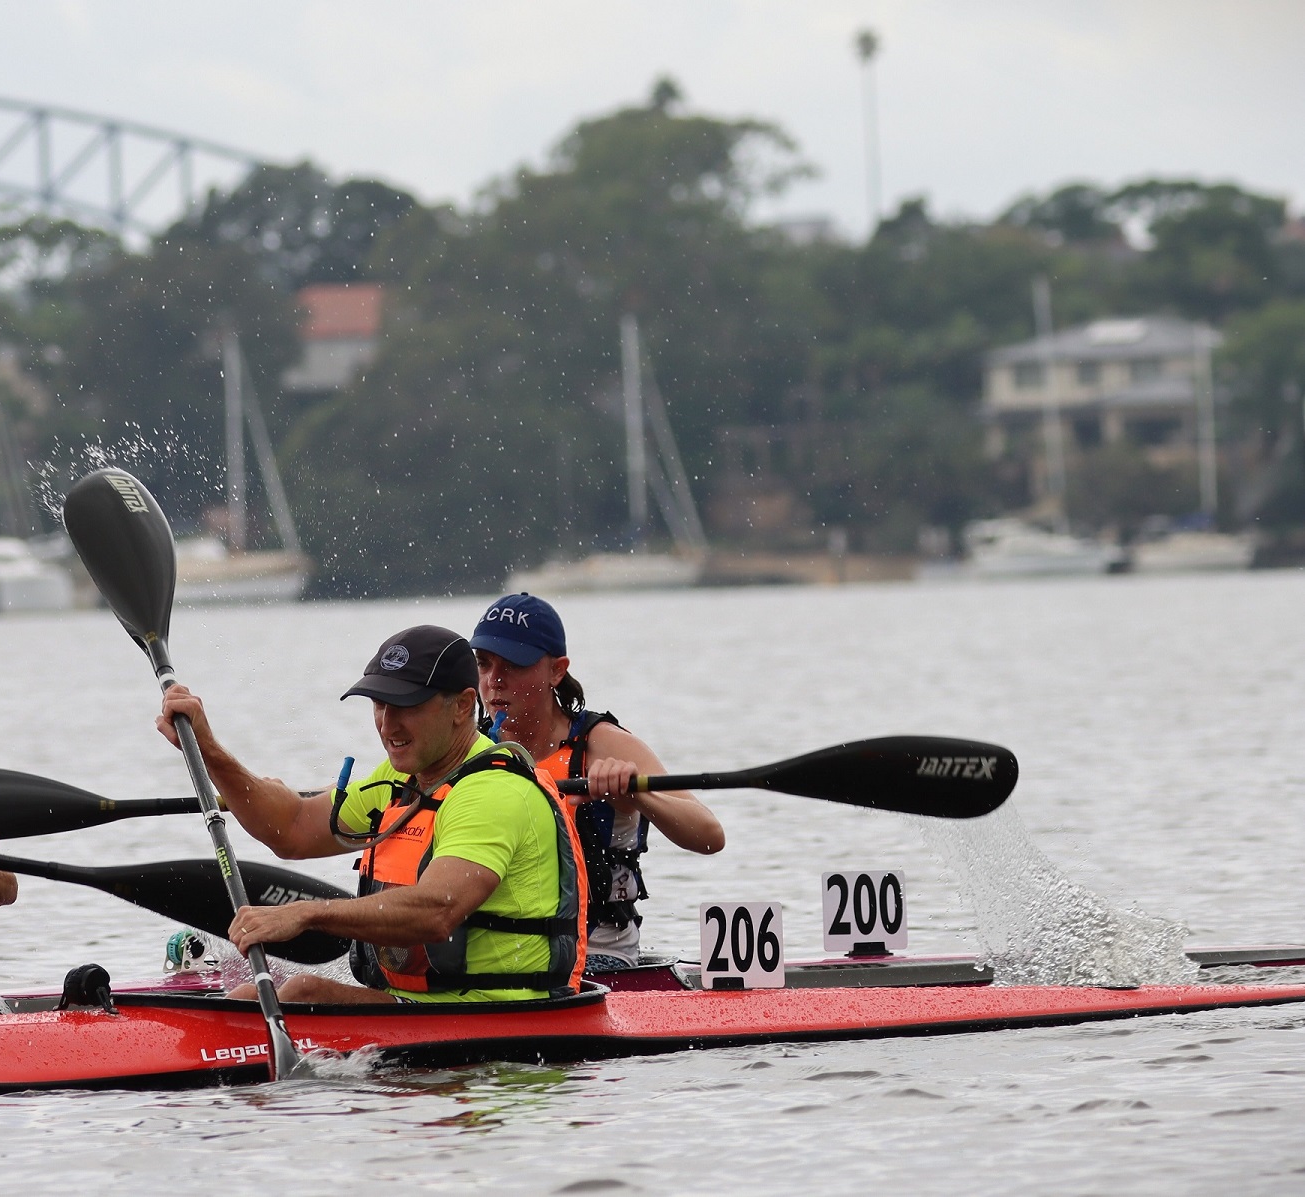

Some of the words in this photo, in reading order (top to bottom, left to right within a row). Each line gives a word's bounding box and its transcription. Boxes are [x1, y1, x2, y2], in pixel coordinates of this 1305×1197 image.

[917, 757, 997, 779] JANTEX
[827, 873, 904, 935] 200
[706, 906, 780, 972] 206
[201, 1044, 268, 1063] Legac
[294, 1038, 318, 1050] XL
